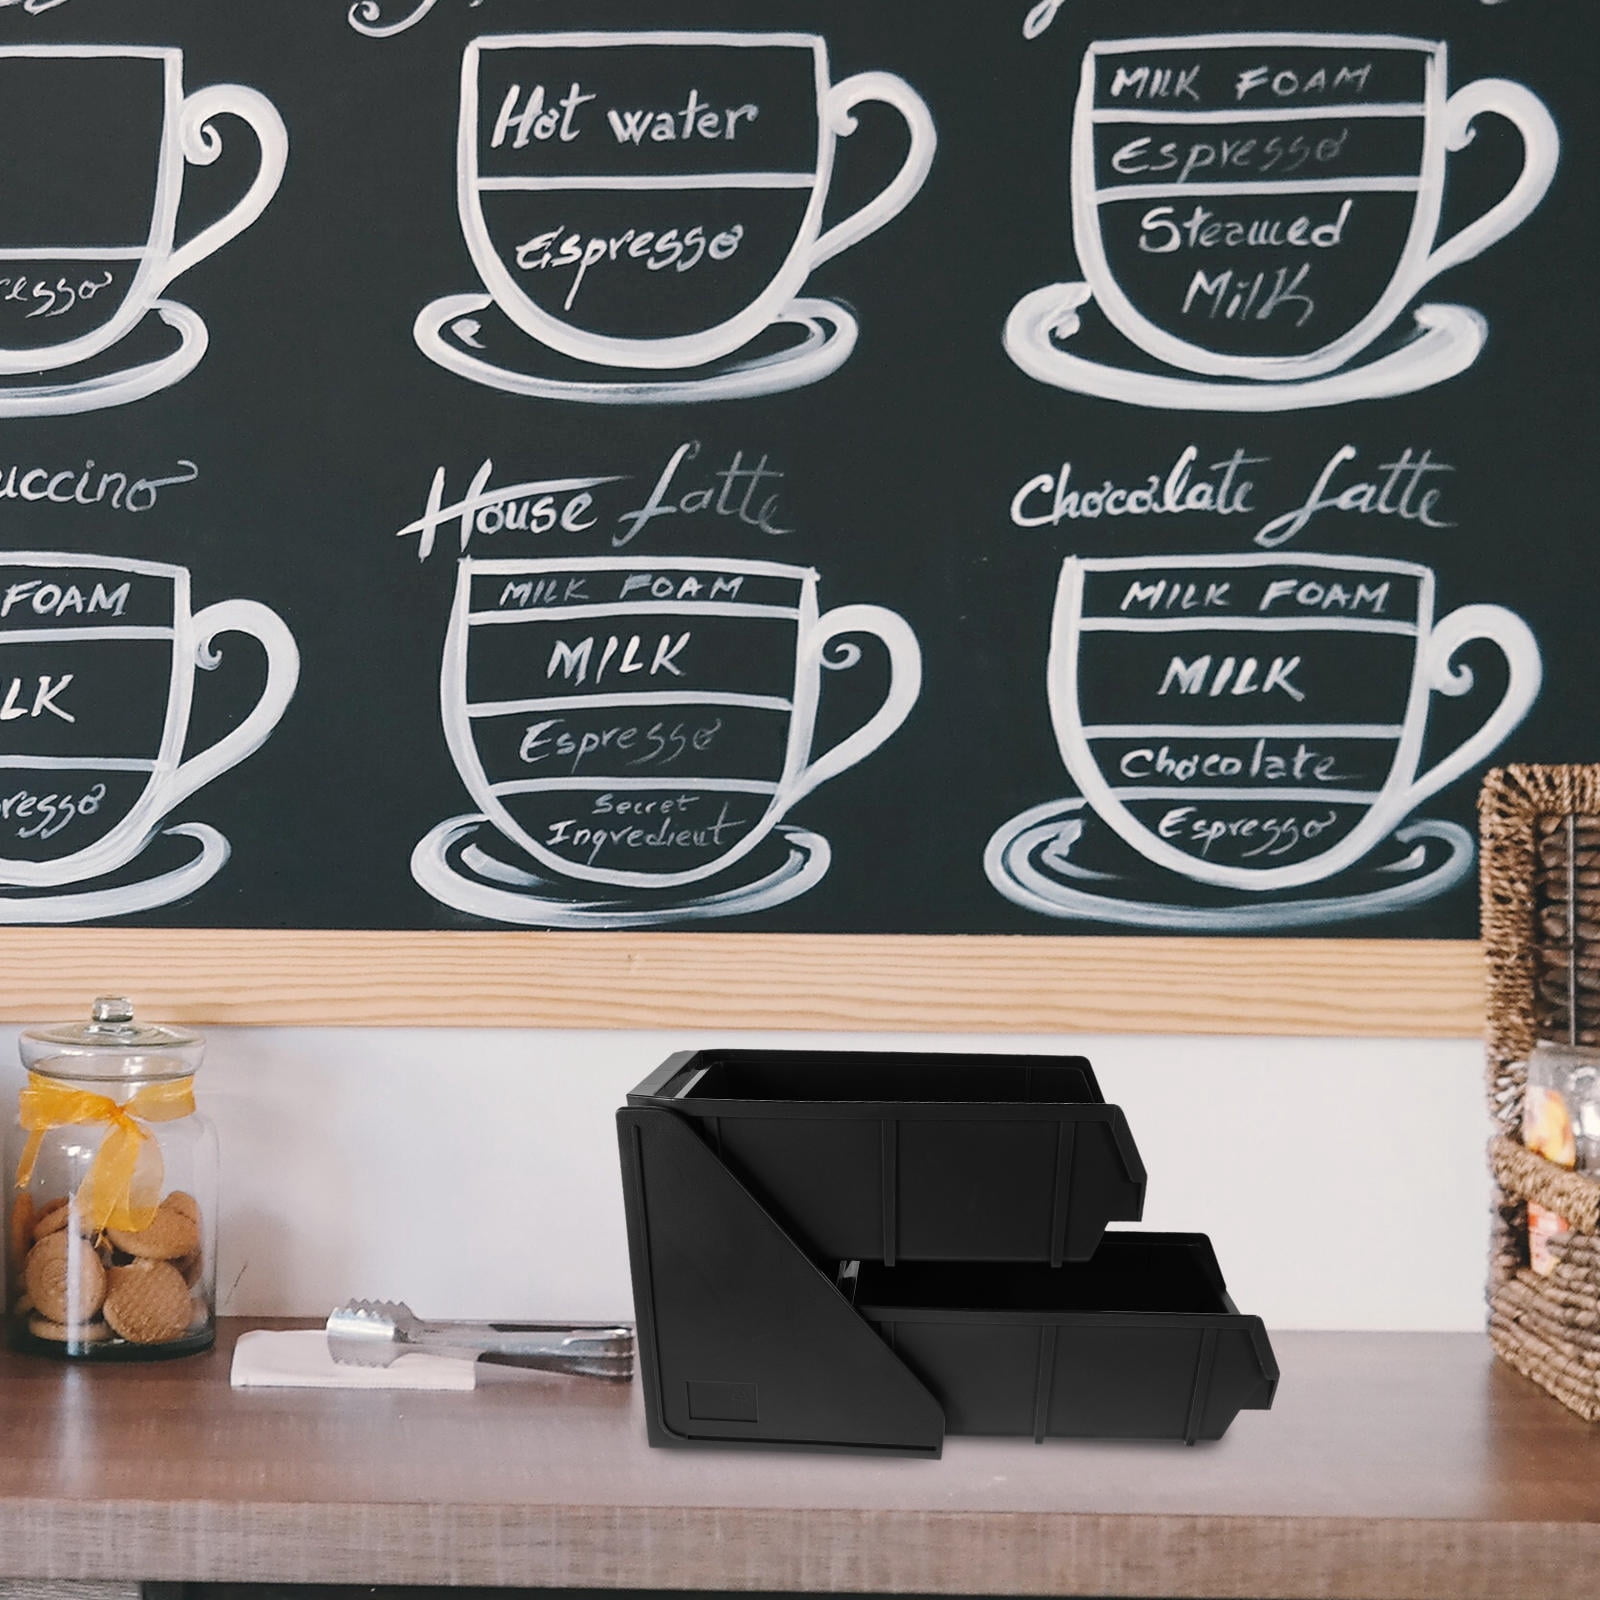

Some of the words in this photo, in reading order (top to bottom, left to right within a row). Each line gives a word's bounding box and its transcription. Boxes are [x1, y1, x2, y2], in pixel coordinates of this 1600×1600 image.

[1111, 65, 1200, 100] MILK
[1235, 64, 1371, 100] FOAM
[491, 82, 596, 149] Hot
[607, 89, 759, 146] water
[1112, 128, 1348, 182] Espresso
[1139, 199, 1353, 253] Steamed
[515, 224, 745, 309] Espresso
[396, 458, 634, 563] House
[1010, 445, 1271, 527] Chocolate
[1254, 444, 1458, 548] Latte
[1, 580, 130, 617] FOAM
[499, 577, 589, 606] MILK
[619, 574, 744, 600] FOAM
[1120, 580, 1230, 611] MILK
[1259, 579, 1390, 613] FOAM
[547, 632, 691, 686] MILK
[1157, 655, 1305, 702] MILK
[520, 719, 721, 773] Espresso
[1119, 739, 1360, 781] Chocolate
[0, 783, 107, 838] resso
[592, 793, 699, 814] Secret
[1157, 806, 1337, 857] Espresso
